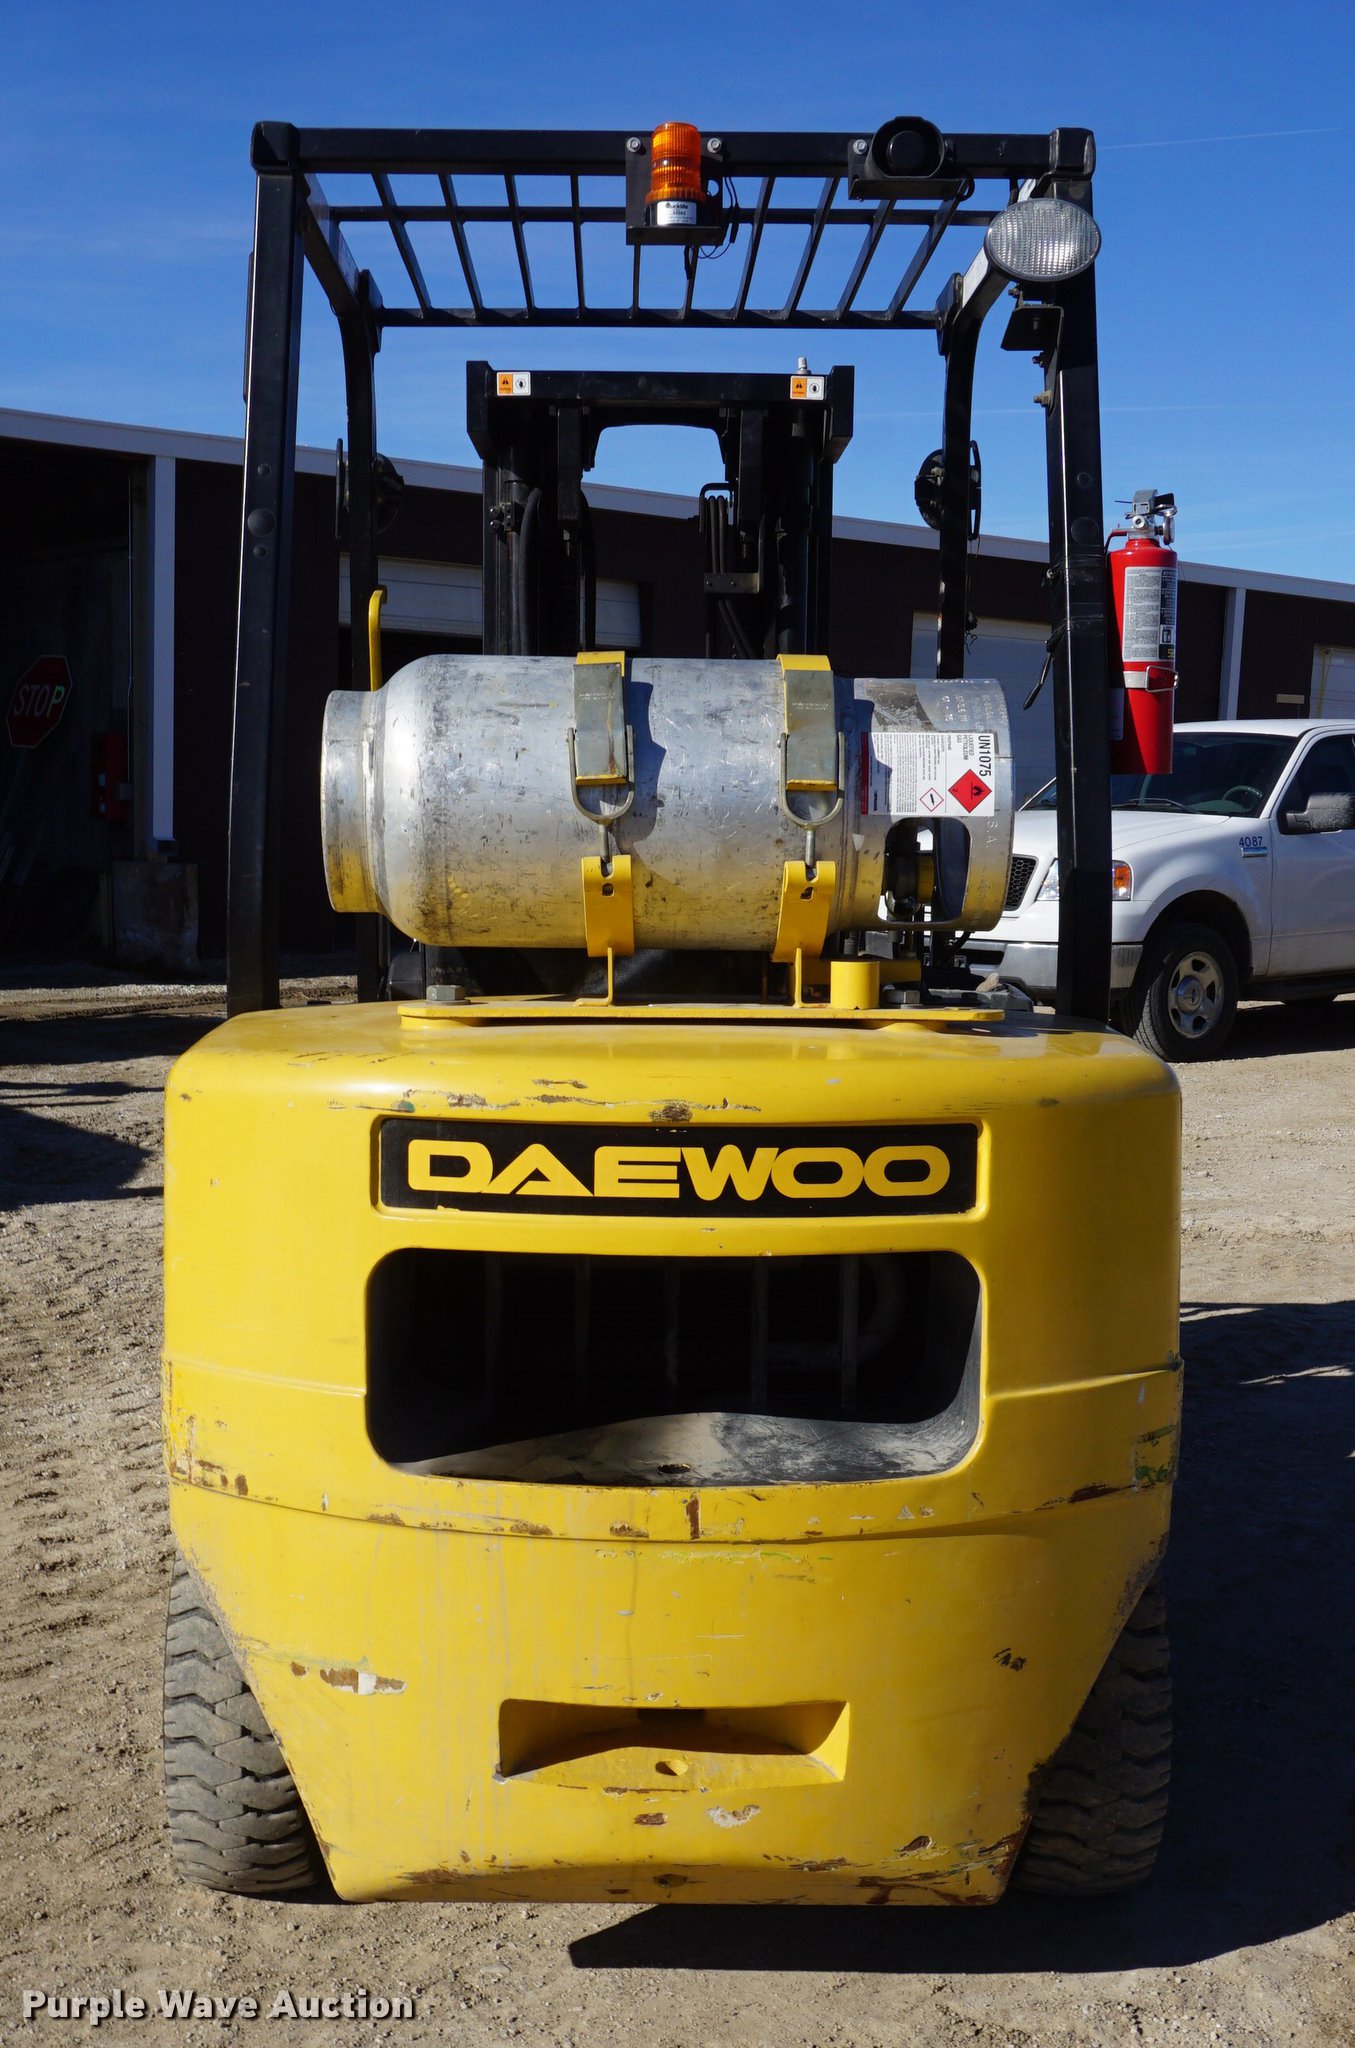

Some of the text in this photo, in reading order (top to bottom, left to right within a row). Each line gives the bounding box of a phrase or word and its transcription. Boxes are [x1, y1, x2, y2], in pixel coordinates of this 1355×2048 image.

[13, 684, 65, 718] STOP
[978, 735, 992, 777] UN1075
[985, 816, 998, 848] .S.A.
[1239, 836, 1263, 848] 4087
[407, 1139, 951, 1201] DAEWOO
